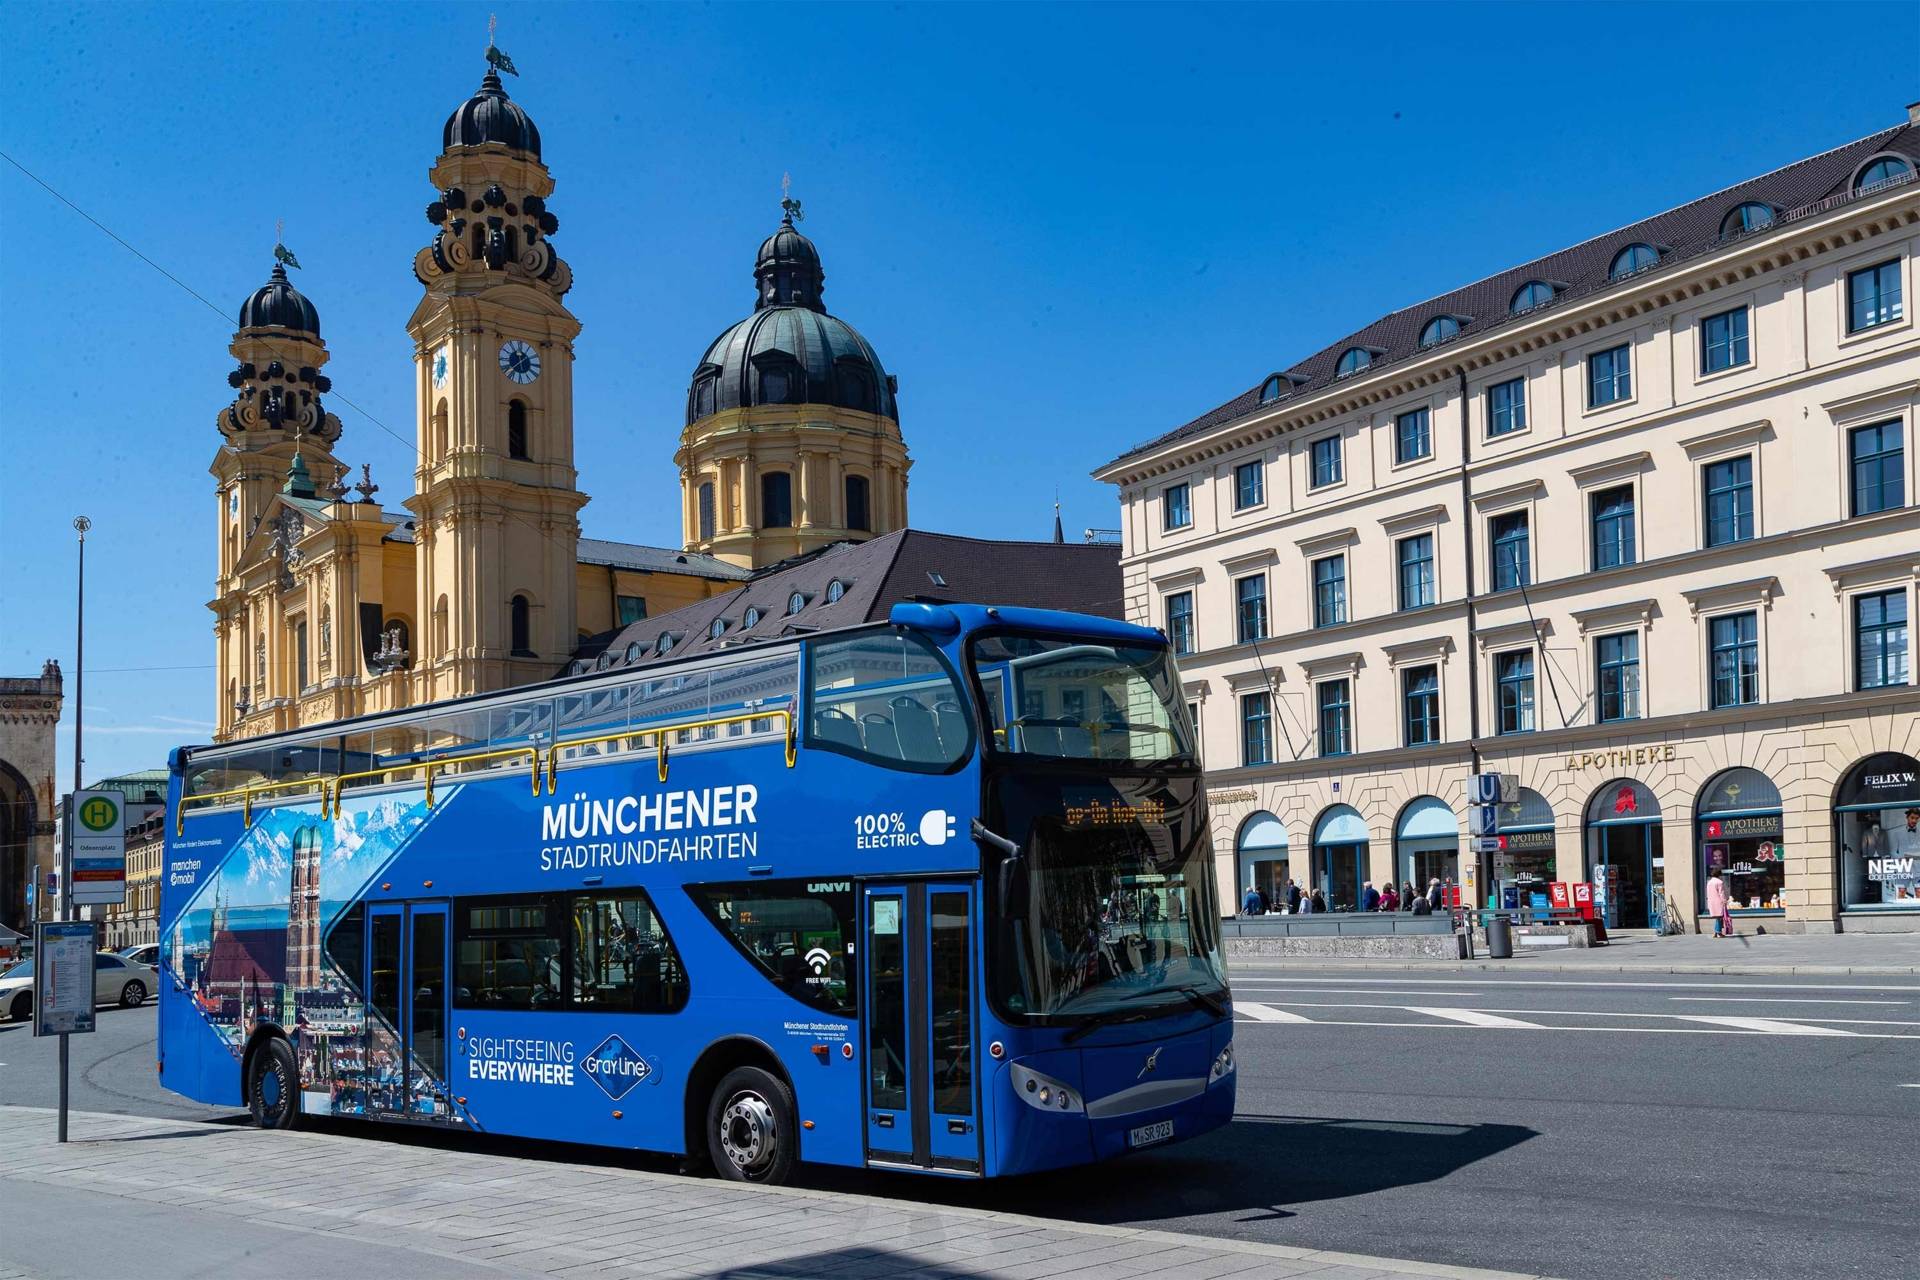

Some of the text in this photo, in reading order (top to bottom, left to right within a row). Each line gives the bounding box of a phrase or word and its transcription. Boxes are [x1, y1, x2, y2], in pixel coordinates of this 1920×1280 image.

[1567, 745, 1677, 772] APOTHEKE
[1480, 776, 1496, 801] U
[1864, 772, 1916, 786] FELIX W.
[91, 804, 107, 825] H
[541, 783, 759, 841] MÜNCHENER
[854, 812, 906, 835] 100%
[1724, 817, 1779, 830] APOTHEKE
[857, 832, 920, 849] ELECTRIC
[1509, 833, 1554, 844] APOTHEKE
[540, 832, 758, 871] STADTRUNDFAHRTEN
[1868, 858, 1914, 875] NEW
[1868, 873, 1914, 881] COLLECTION
[807, 882, 851, 893] UNVI
[805, 977, 819, 985] FREE
[469, 1037, 574, 1063] SIGHTSEEING
[469, 1059, 574, 1086] EVERYWHERE
[1133, 1122, 1170, 1145] M SR 923
